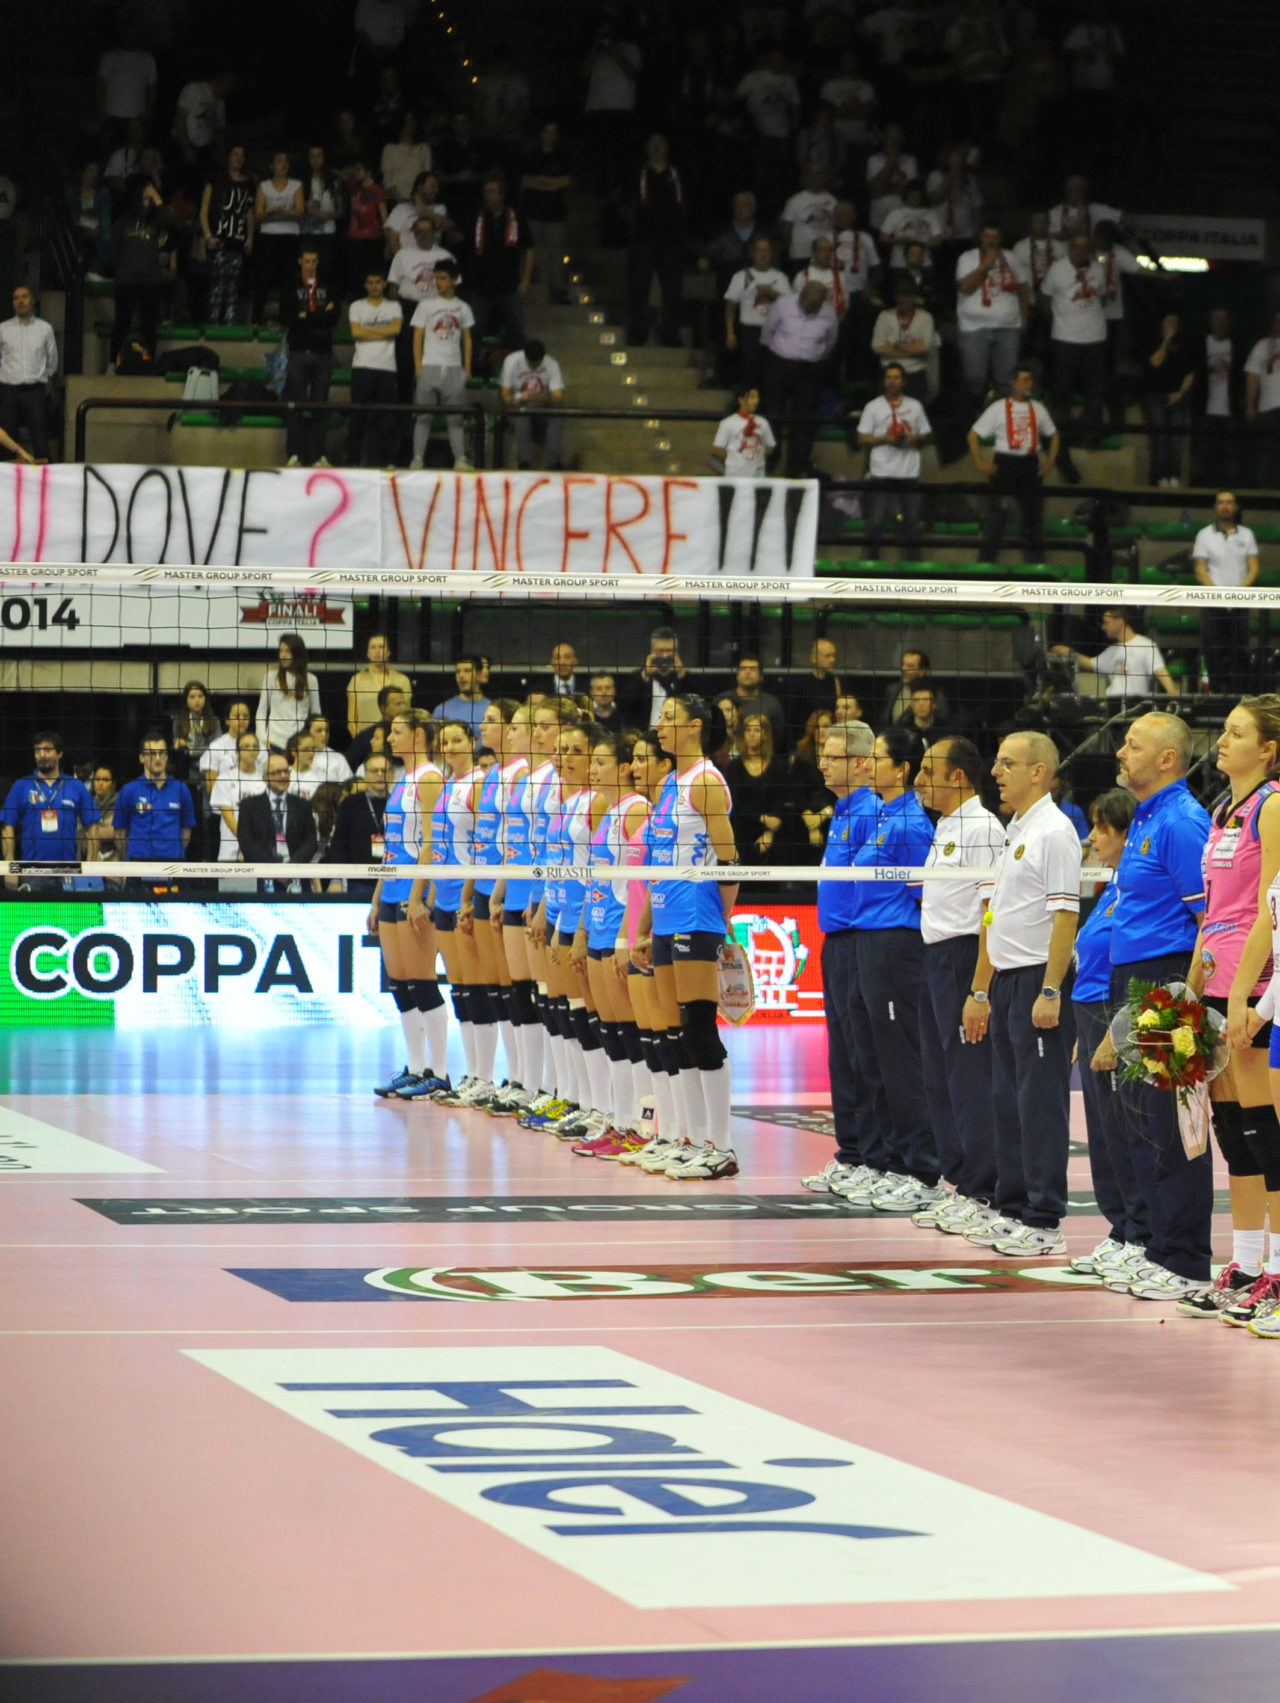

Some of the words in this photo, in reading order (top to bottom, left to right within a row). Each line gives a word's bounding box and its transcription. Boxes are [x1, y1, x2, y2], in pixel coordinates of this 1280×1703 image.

[31, 568, 65, 577] GROUP
[67, 568, 98, 577] SPORT
[164, 570, 203, 580] MASTER
[205, 571, 240, 581] GROUP
[242, 572, 272, 582] SPORT
[340, 573, 378, 583] MASTER
[380, 574, 415, 584] GROUP
[417, 575, 447, 585] SPORT
[512, 576, 551, 586] MASTER
[553, 577, 587, 587] GROUP
[589, 578, 619, 588] SPORT
[685, 579, 724, 589] MASTER
[726, 580, 759, 590] GROUP
[761, 581, 791, 591] SPORT
[854, 583, 892, 593] MASTER
[894, 584, 927, 594] GROUP
[929, 585, 958, 595] SPORT
[1021, 586, 1059, 597] MASTER
[1061, 587, 1093, 598] GROUP
[1095, 588, 1124, 599] SPORT
[1186, 591, 1222, 600] MASTER
[1225, 592, 1256, 601] GROUP
[268, 604, 318, 617] FINALI
[368, 865, 397, 873] molten
[874, 868, 912, 880] Haier
[12, 931, 314, 997] COPPA
[276, 1378, 937, 1541] Haier
